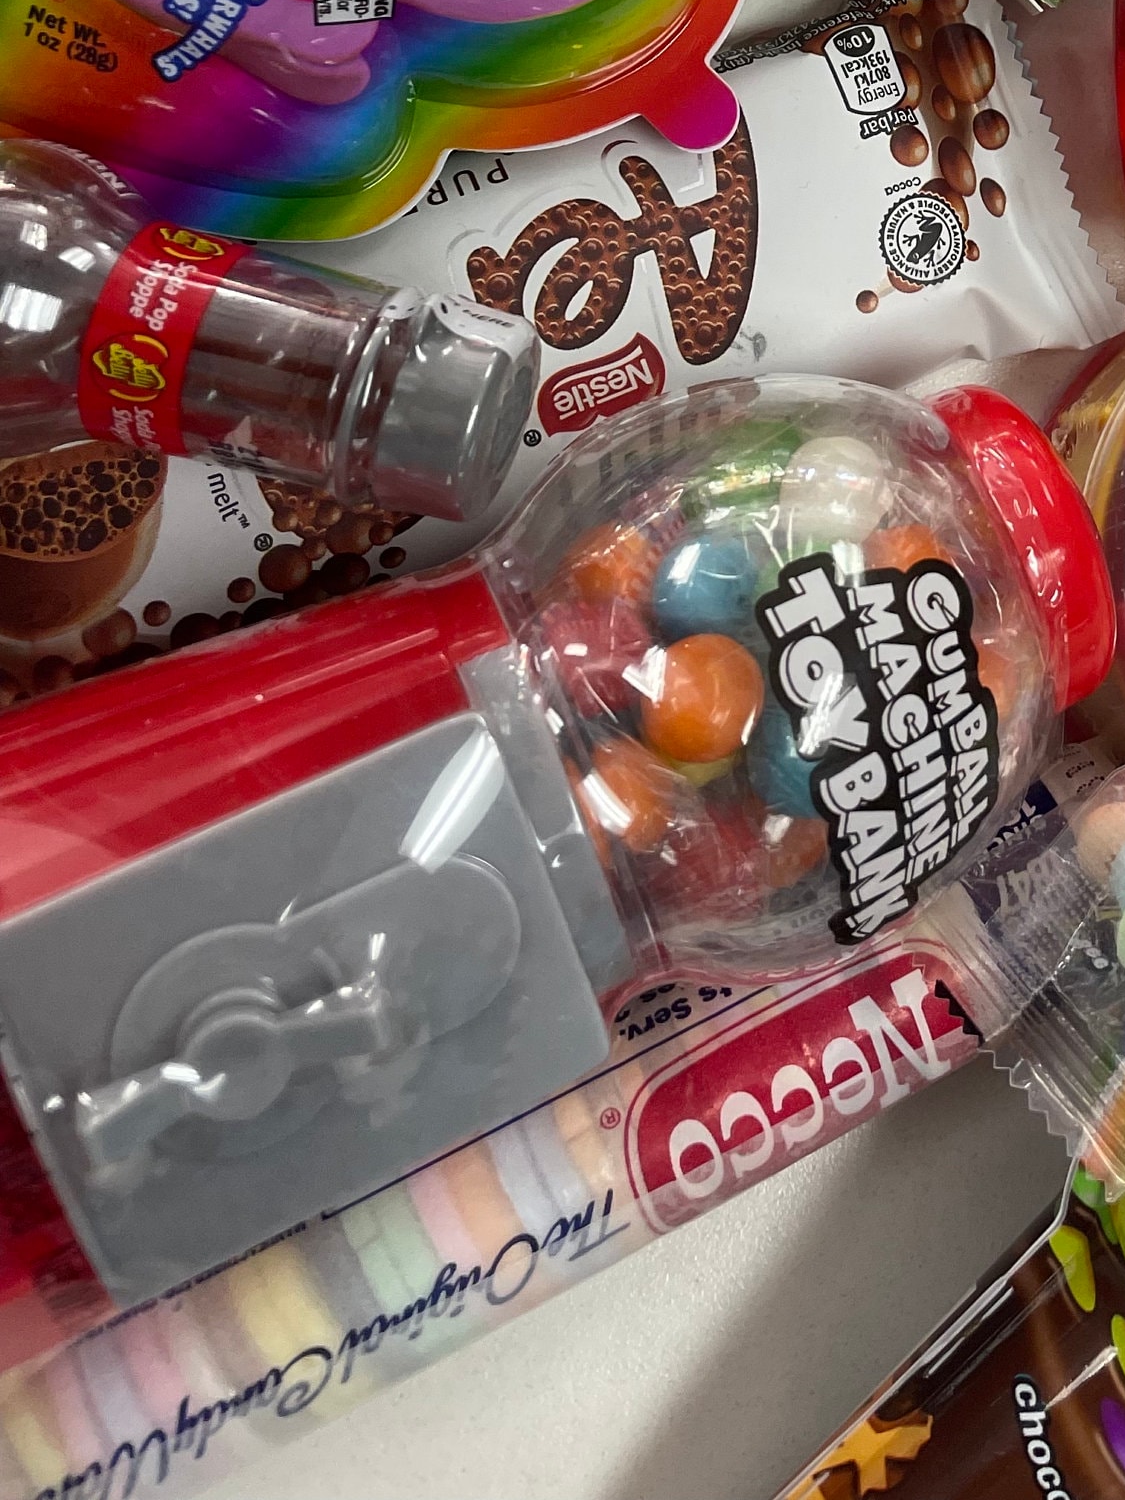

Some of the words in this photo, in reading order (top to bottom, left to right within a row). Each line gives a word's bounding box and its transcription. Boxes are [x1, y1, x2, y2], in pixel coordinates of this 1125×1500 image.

[28, 4, 67, 29] Net
[71, 20, 106, 47] Wt.
[836, 31, 873, 51] 10%
[67, 39, 119, 73] (28g)
[841, 49, 891, 78] 193kcal
[853, 66, 892, 88] 807kJ
[857, 81, 901, 106] Energy
[862, 112, 892, 138] bar
[884, 176, 921, 196] Cocoa
[886, 205, 909, 240] NATURE
[917, 199, 951, 220] PEOPLE
[888, 248, 931, 278] ALLIANCE
[933, 223, 961, 277] RAINFOREST
[147, 298, 178, 332] Pop
[205, 472, 241, 523] melt
[764, 568, 873, 758] TOY
[906, 570, 992, 850] GUMBALL
[846, 581, 953, 886] MACHINE
[818, 753, 911, 942] BANK
[618, 996, 693, 1042] Serv.
[667, 967, 952, 1201] Necco
[540, 1187, 634, 1261] The
